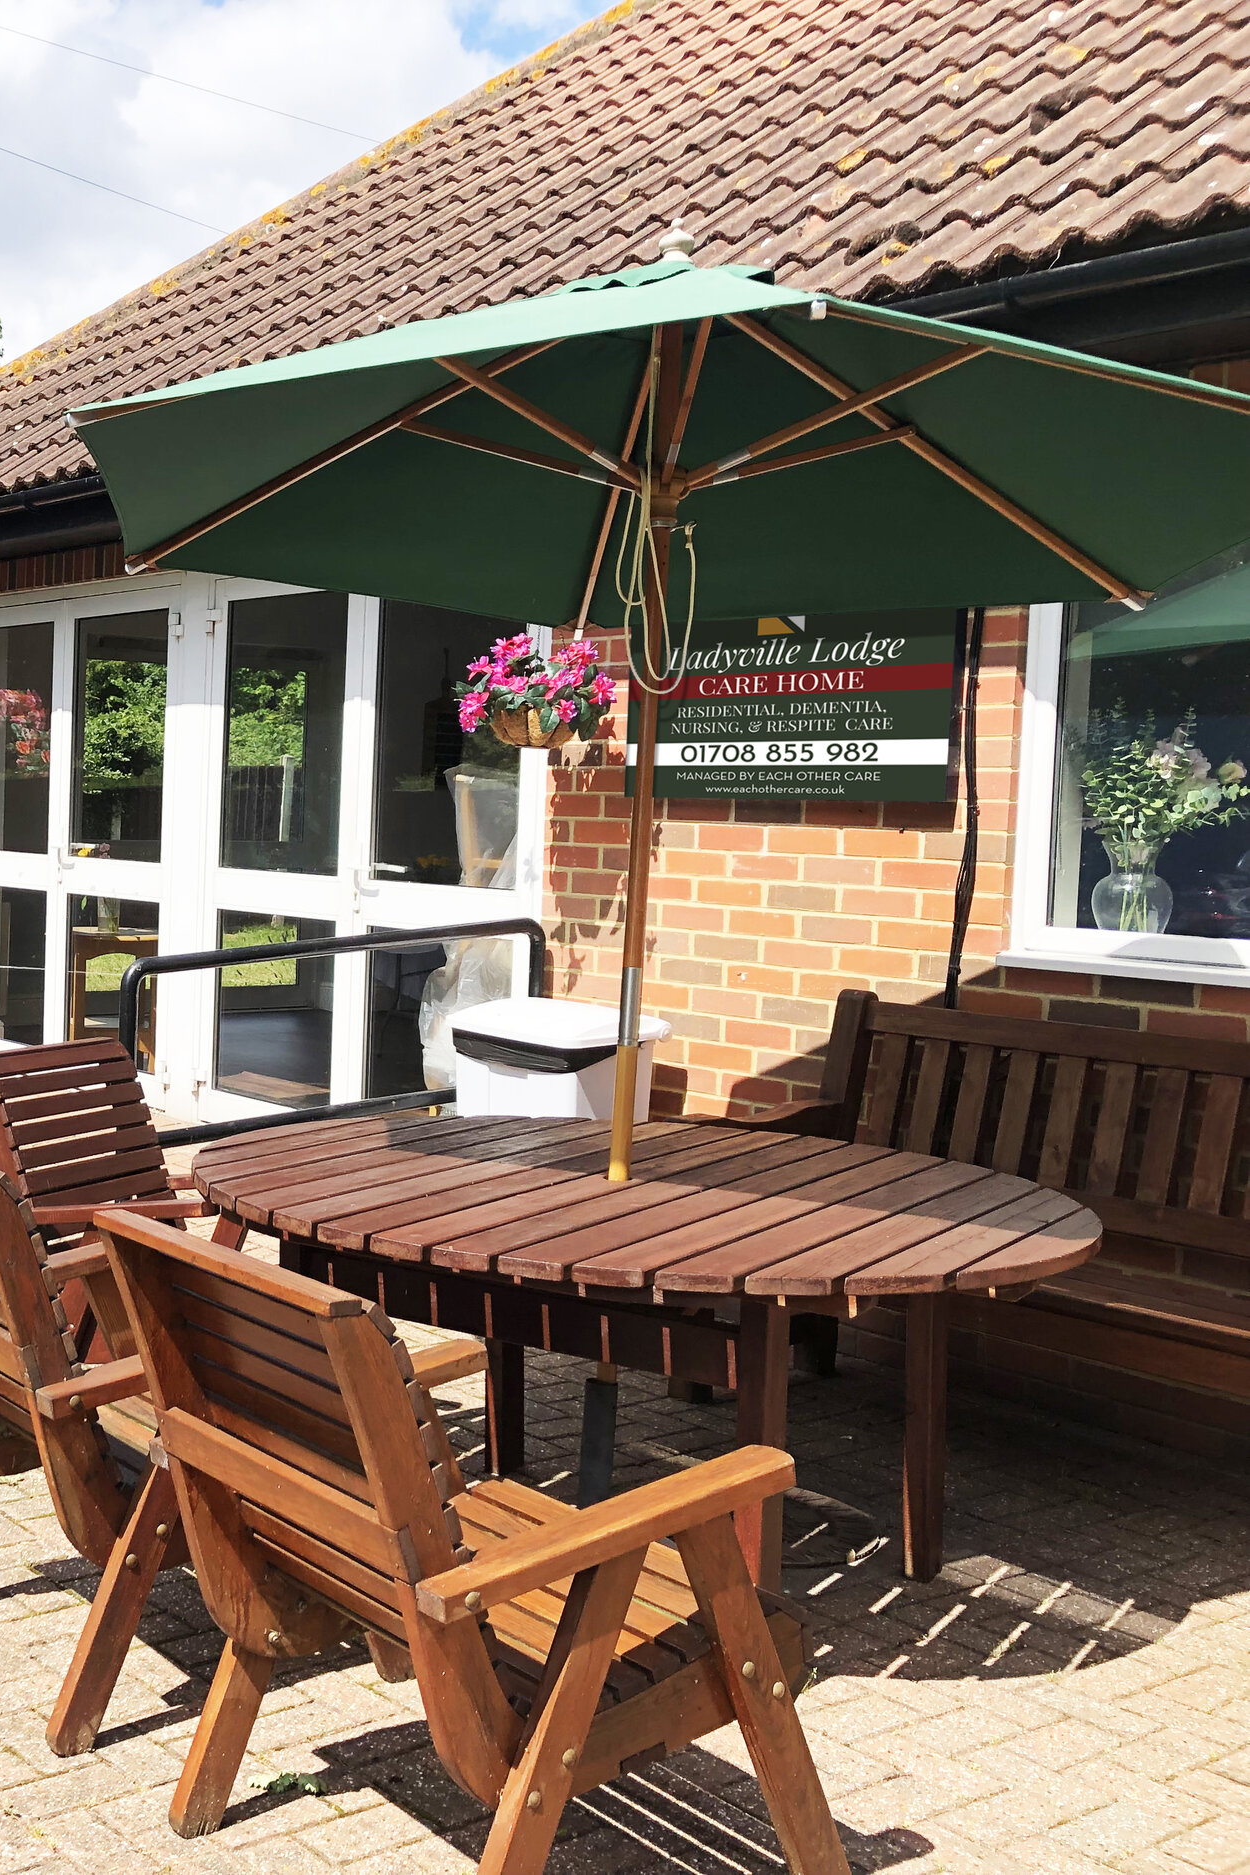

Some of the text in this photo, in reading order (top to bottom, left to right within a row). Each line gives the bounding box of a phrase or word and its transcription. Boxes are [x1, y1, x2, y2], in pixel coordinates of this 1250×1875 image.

[668, 631, 906, 674] Ladyville Lodge
[699, 670, 865, 696] CARE HOME
[677, 700, 887, 719] RESIDENTIAL, DEMENTIA,
[670, 717, 894, 735] NURSING, & RESPITE CARE
[680, 742, 879, 763] 01708 855 982
[676, 771, 881, 782] MANAGED BY EACH OTHER CARE
[705, 784, 845, 795] www.eachothercare.co.uk
